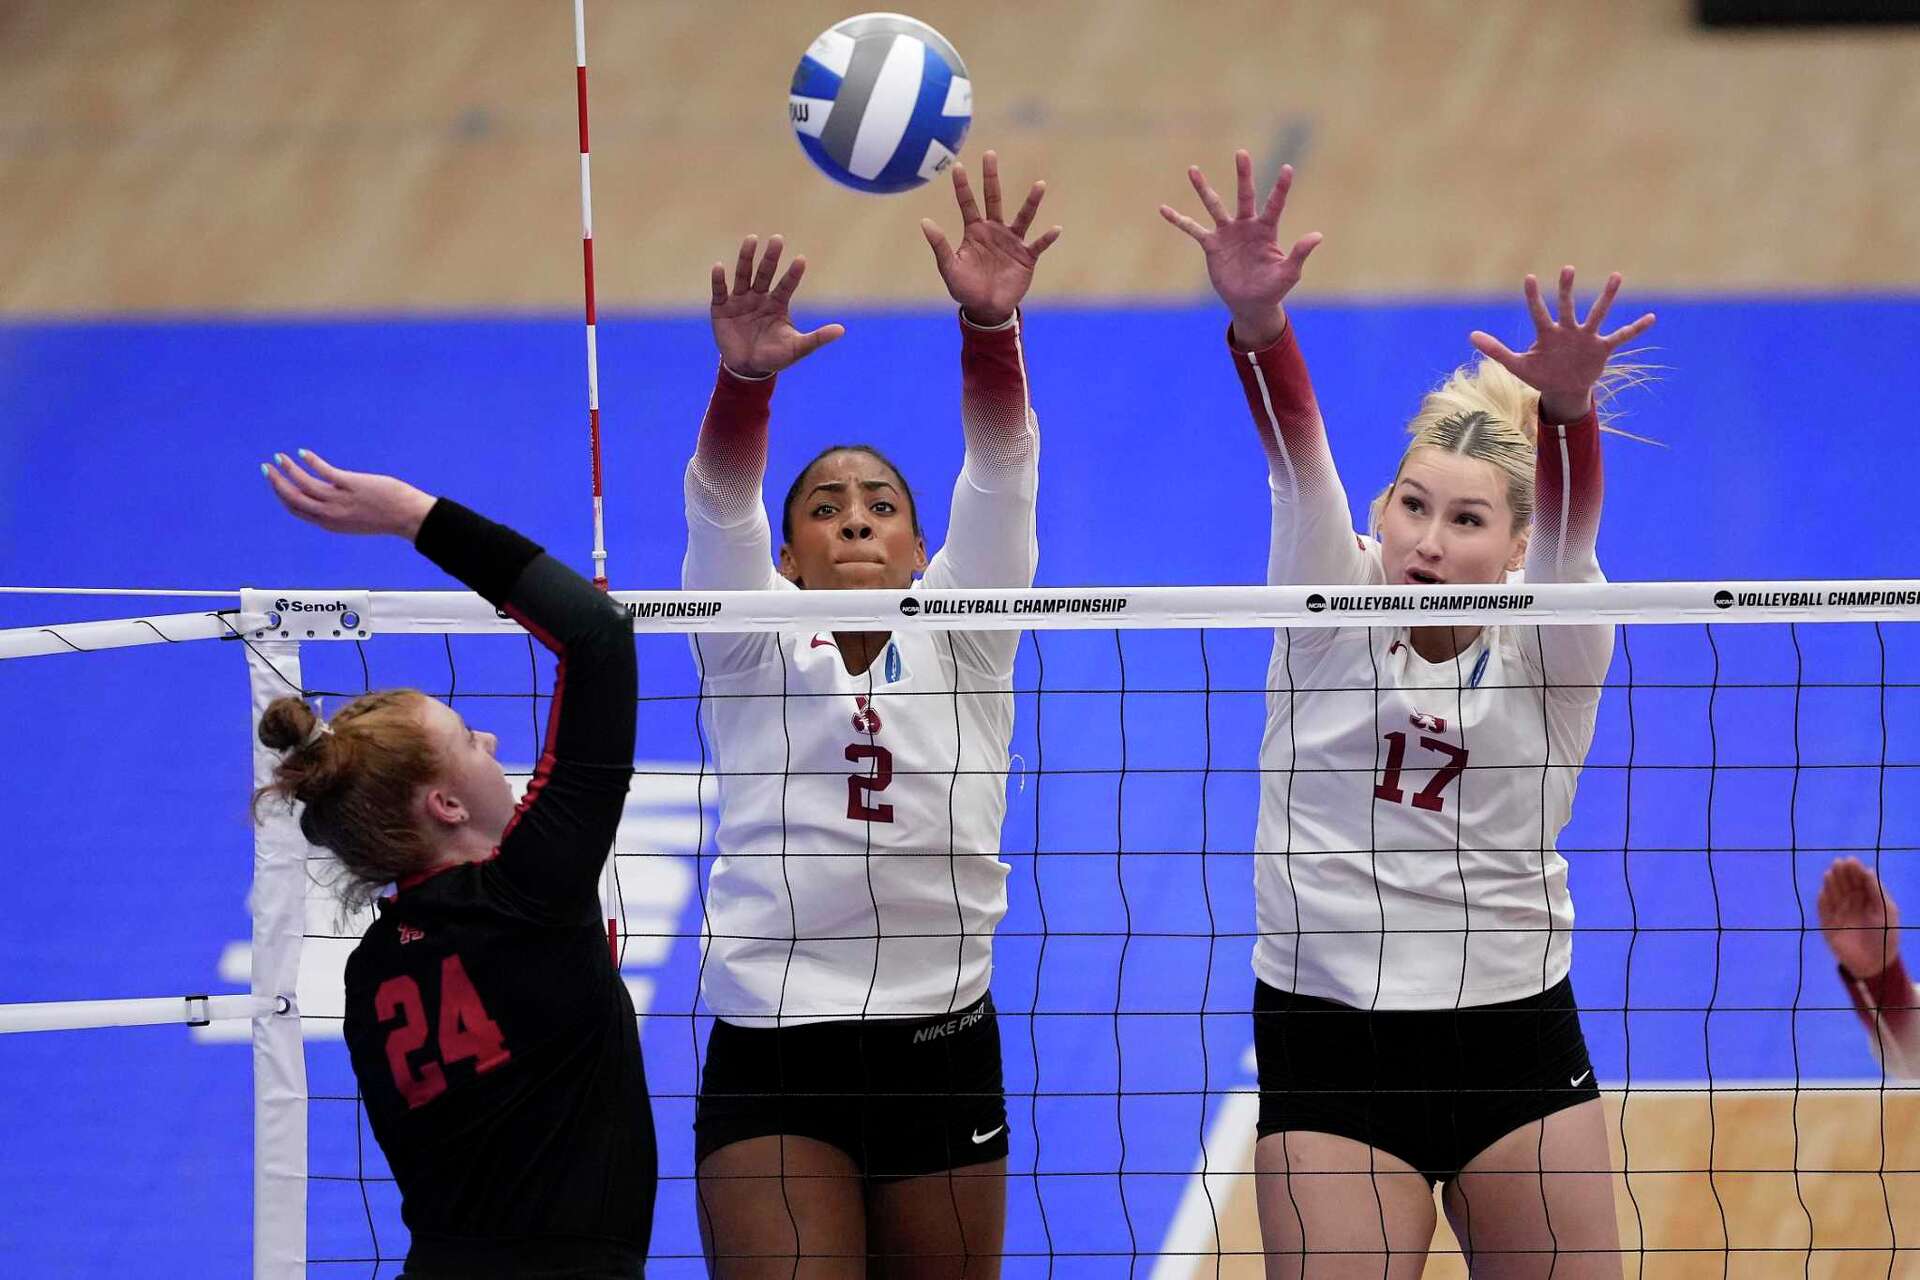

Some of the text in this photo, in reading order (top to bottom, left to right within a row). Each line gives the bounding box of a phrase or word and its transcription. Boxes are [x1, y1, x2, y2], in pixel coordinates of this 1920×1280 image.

[291, 600, 347, 612] Senoh
[924, 599, 1009, 614] VOLLEYBALL
[1013, 598, 1127, 613] CHAMPIONSHIP
[1330, 596, 1415, 611] VOLLEYBALL
[1420, 594, 1534, 610] CHAMPIONSHIP
[1738, 592, 1823, 607] VOLLEYBALL
[625, 602, 722, 617] AMPIONSHIP
[1375, 731, 1469, 812] 17
[845, 743, 894, 823] 2
[375, 953, 512, 1110] 24
[912, 1020, 958, 1044] NIKE
